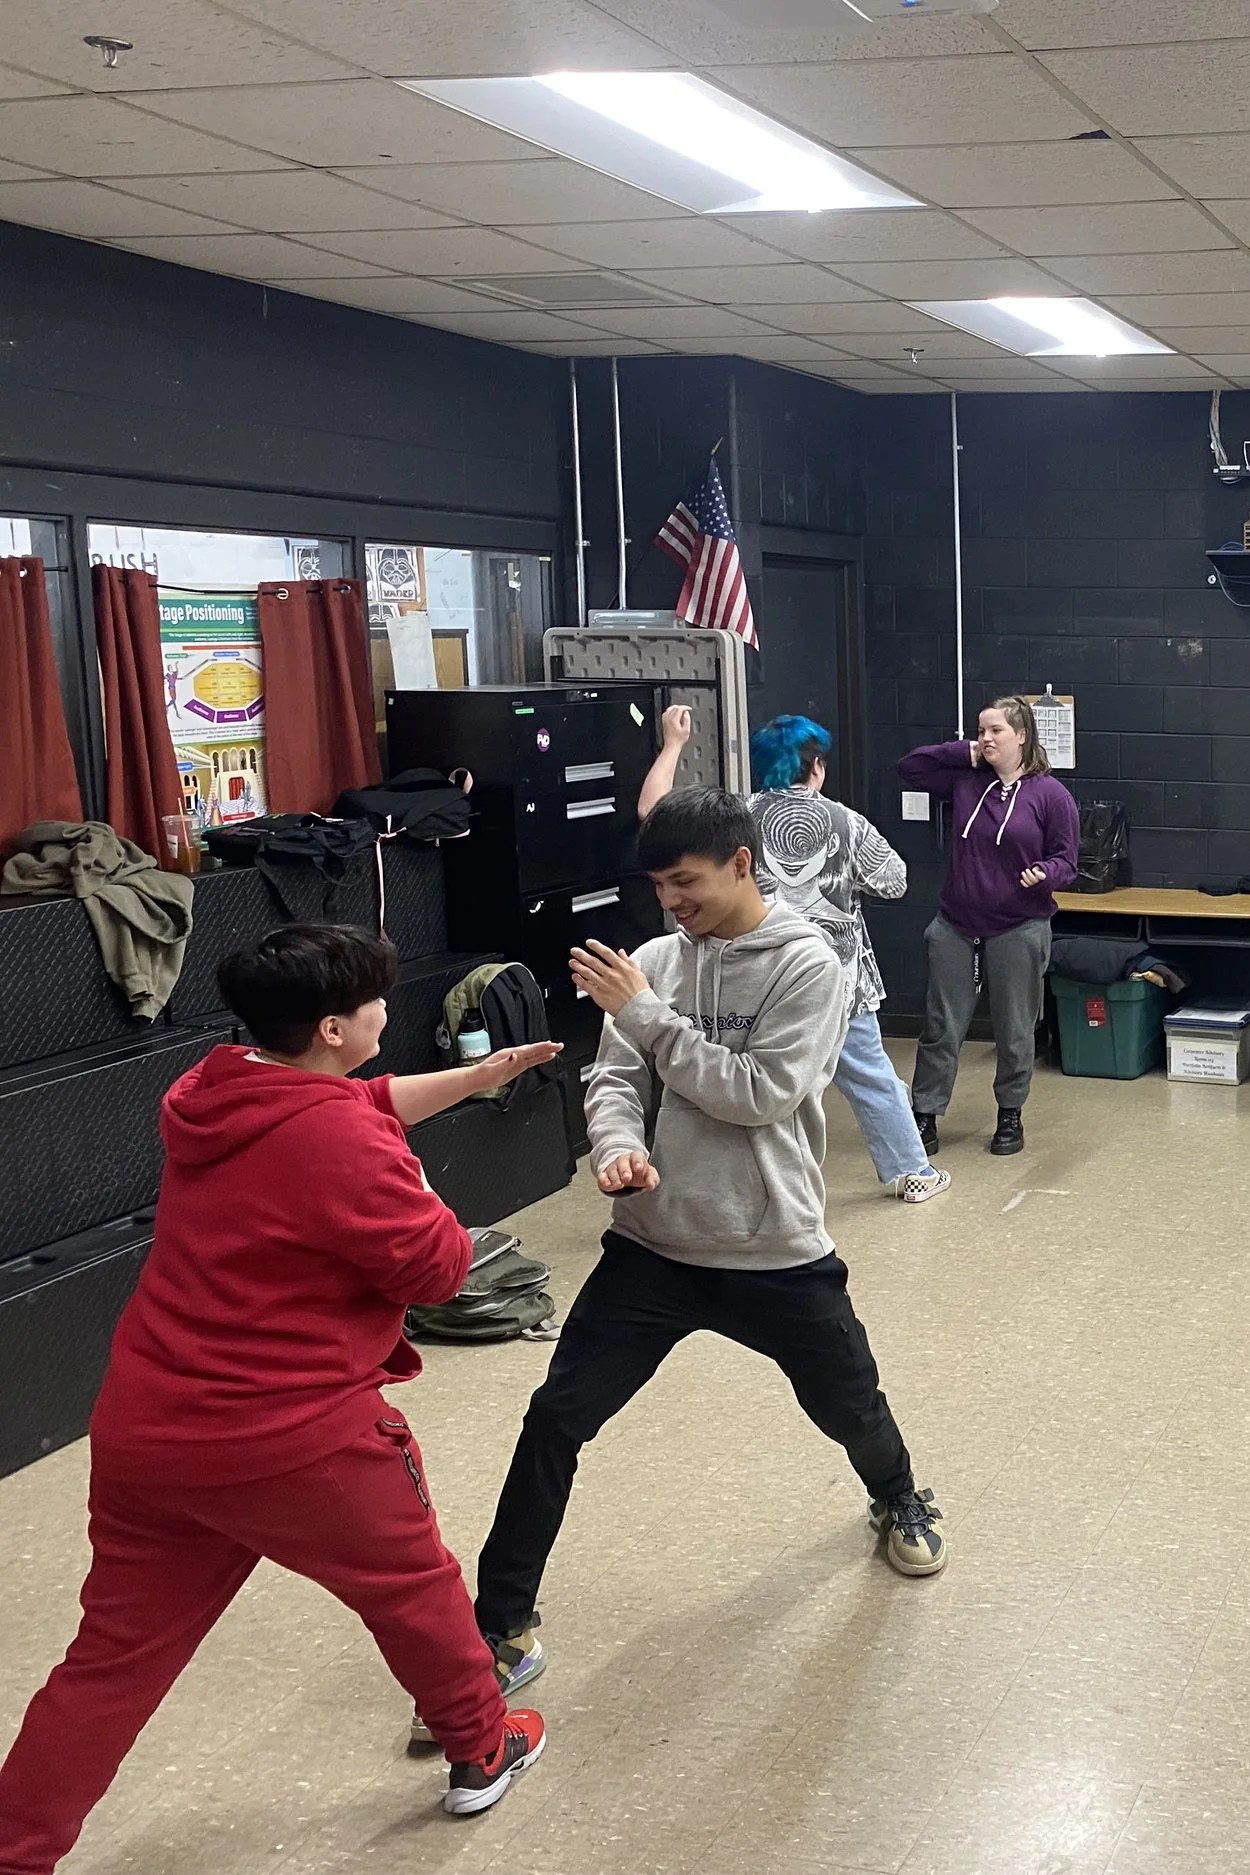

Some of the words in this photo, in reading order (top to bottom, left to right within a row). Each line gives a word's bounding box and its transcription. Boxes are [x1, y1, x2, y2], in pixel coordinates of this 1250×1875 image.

[383, 590, 414, 598] VADER
[159, 604, 184, 624] tage
[185, 604, 244, 624] Positioning
